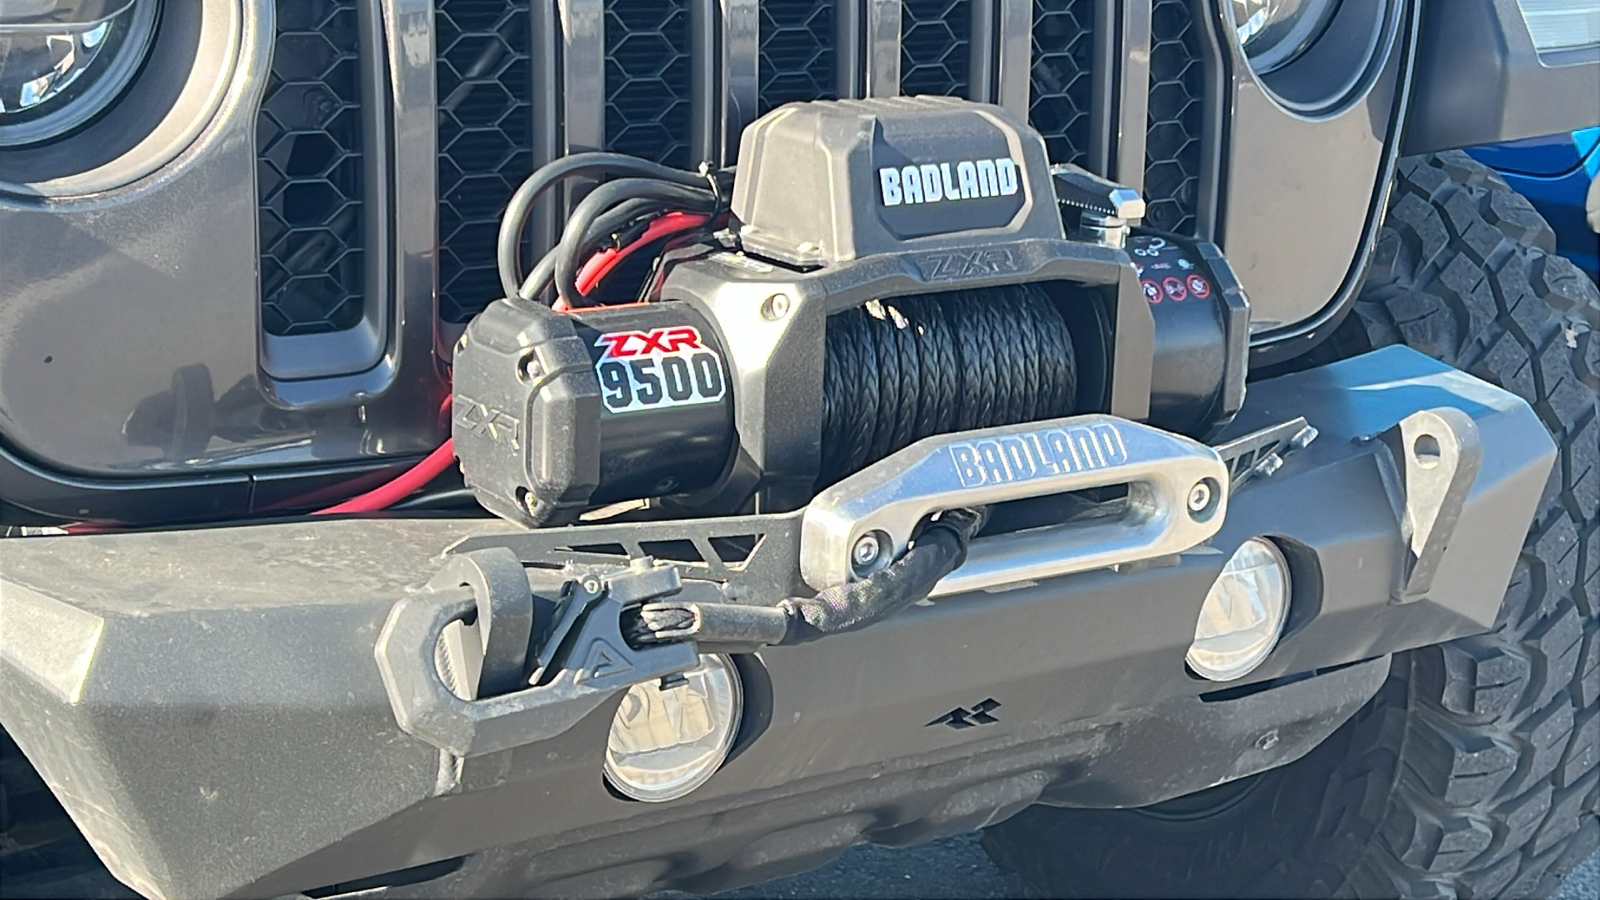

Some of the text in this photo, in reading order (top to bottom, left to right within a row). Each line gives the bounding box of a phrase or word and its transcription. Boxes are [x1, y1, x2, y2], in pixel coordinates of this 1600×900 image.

[880, 158, 1018, 206] BADLAND
[926, 248, 1018, 280] ZXR
[598, 327, 702, 357] ZXR
[599, 352, 722, 408] 9500
[949, 423, 1128, 488] BADLAND
